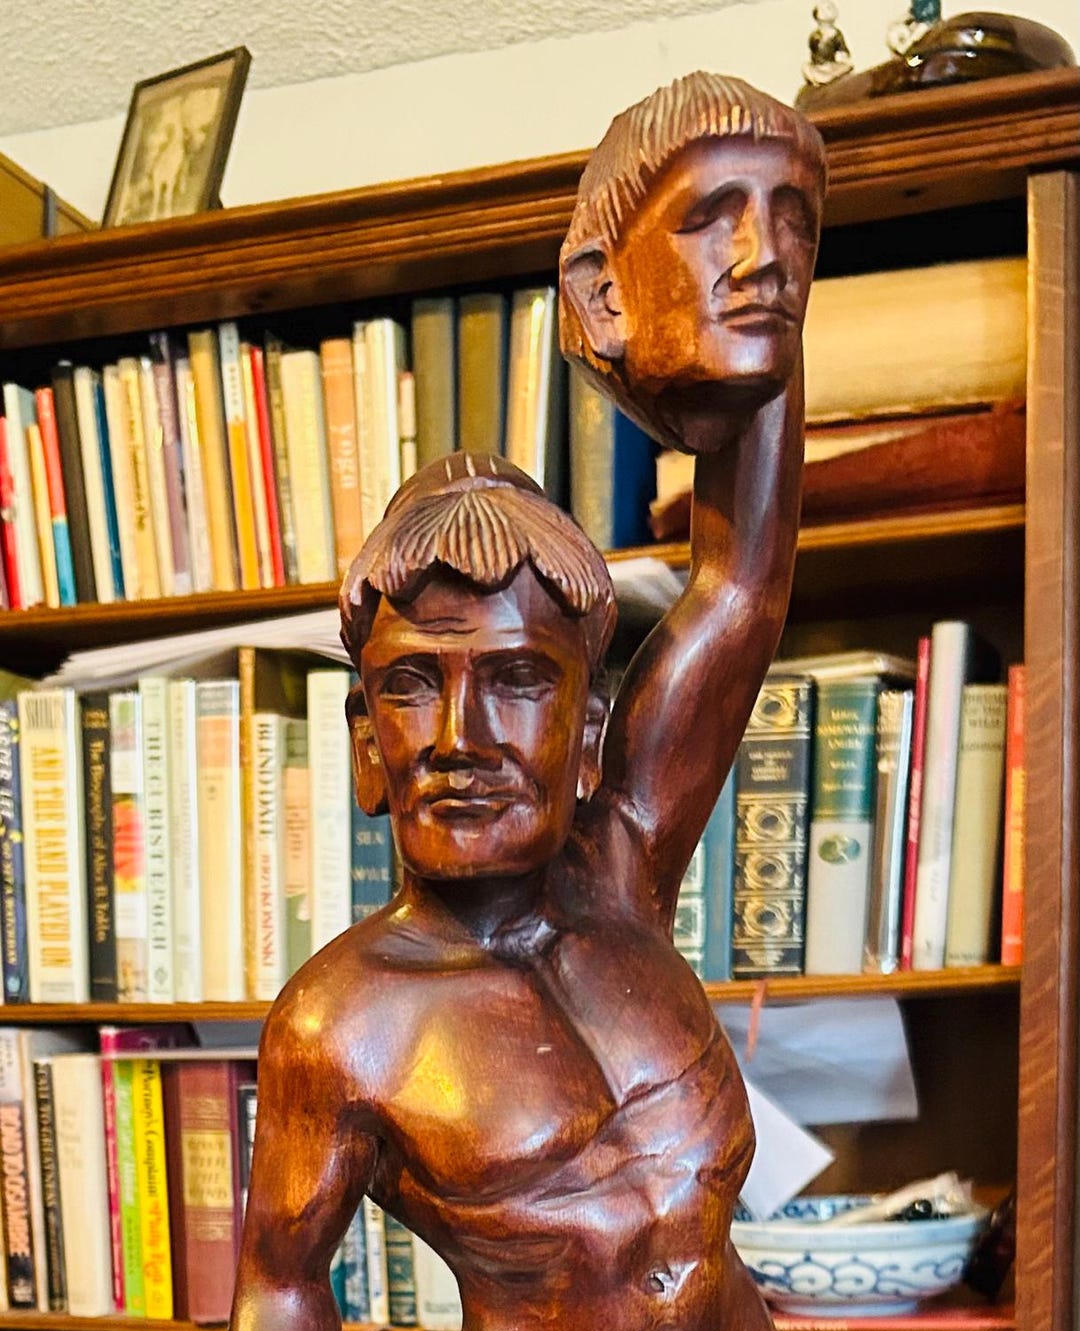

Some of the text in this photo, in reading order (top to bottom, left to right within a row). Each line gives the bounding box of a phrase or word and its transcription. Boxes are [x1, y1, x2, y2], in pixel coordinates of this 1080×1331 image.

[258, 723, 275, 786] BLIND
[31, 746, 72, 968] AND THE BAND PLAYED ON
[142, 1130, 160, 1198] Complaint
